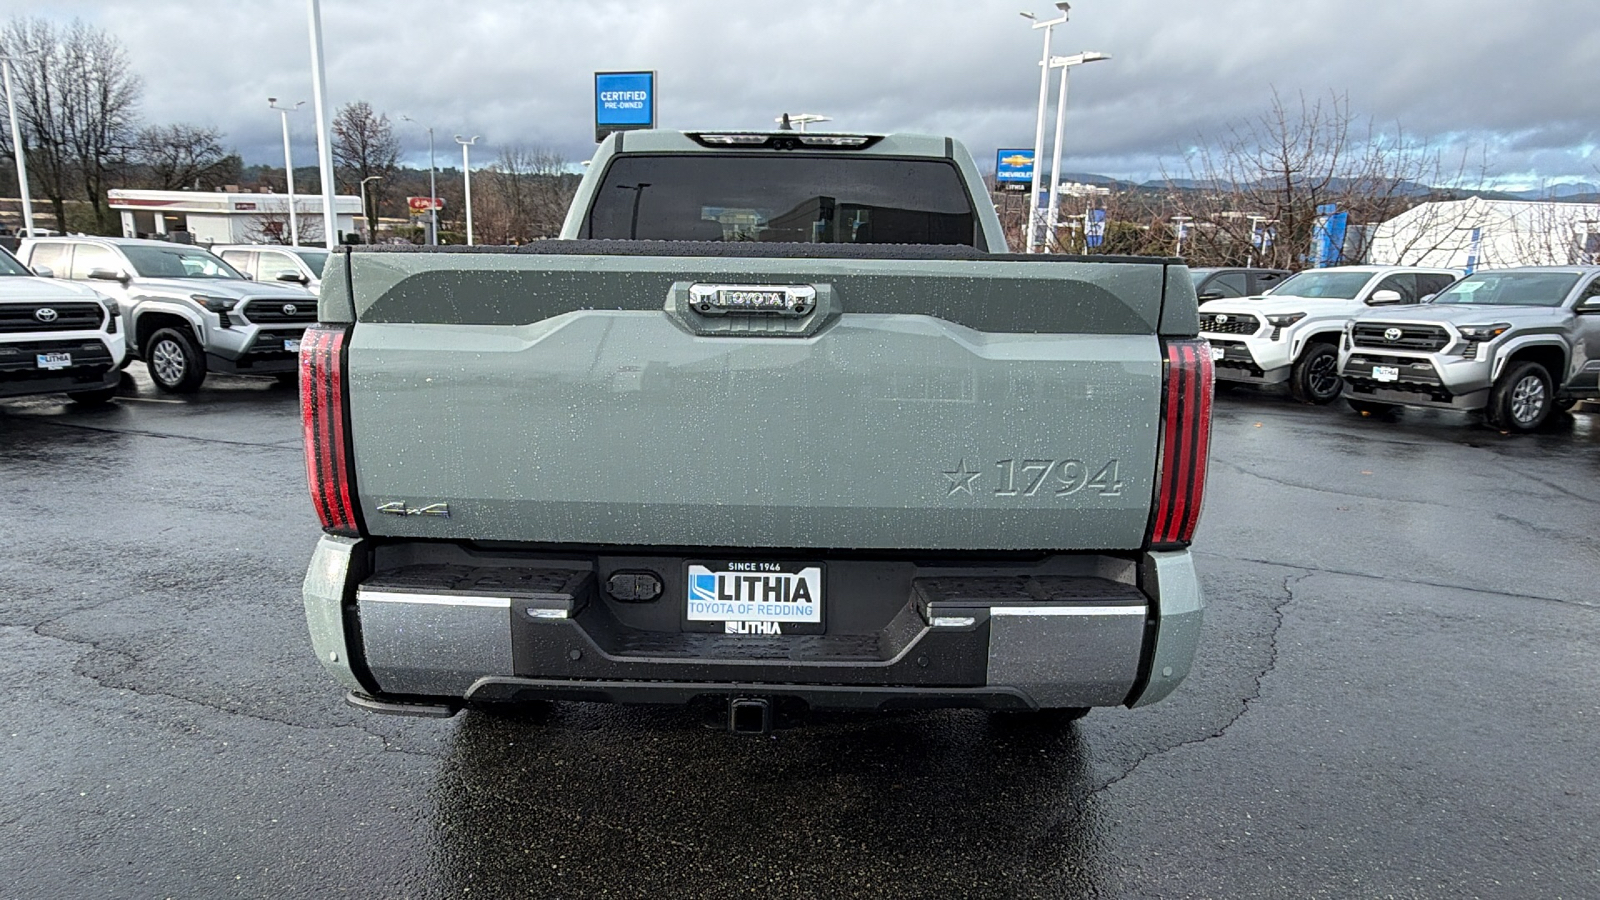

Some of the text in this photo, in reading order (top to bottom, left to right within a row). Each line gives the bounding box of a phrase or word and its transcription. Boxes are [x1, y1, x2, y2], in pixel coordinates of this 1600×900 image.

[600, 91, 647, 101] CERTIFIED
[721, 291, 783, 305] TOYOTA
[45, 355, 70, 363] LITHIA
[994, 459, 1123, 497] 1794
[728, 562, 781, 571] SINCE 1946
[718, 575, 813, 603] LITHIA
[690, 602, 813, 616] TOYOTA OF REDDING
[738, 621, 782, 635] LITHIA
